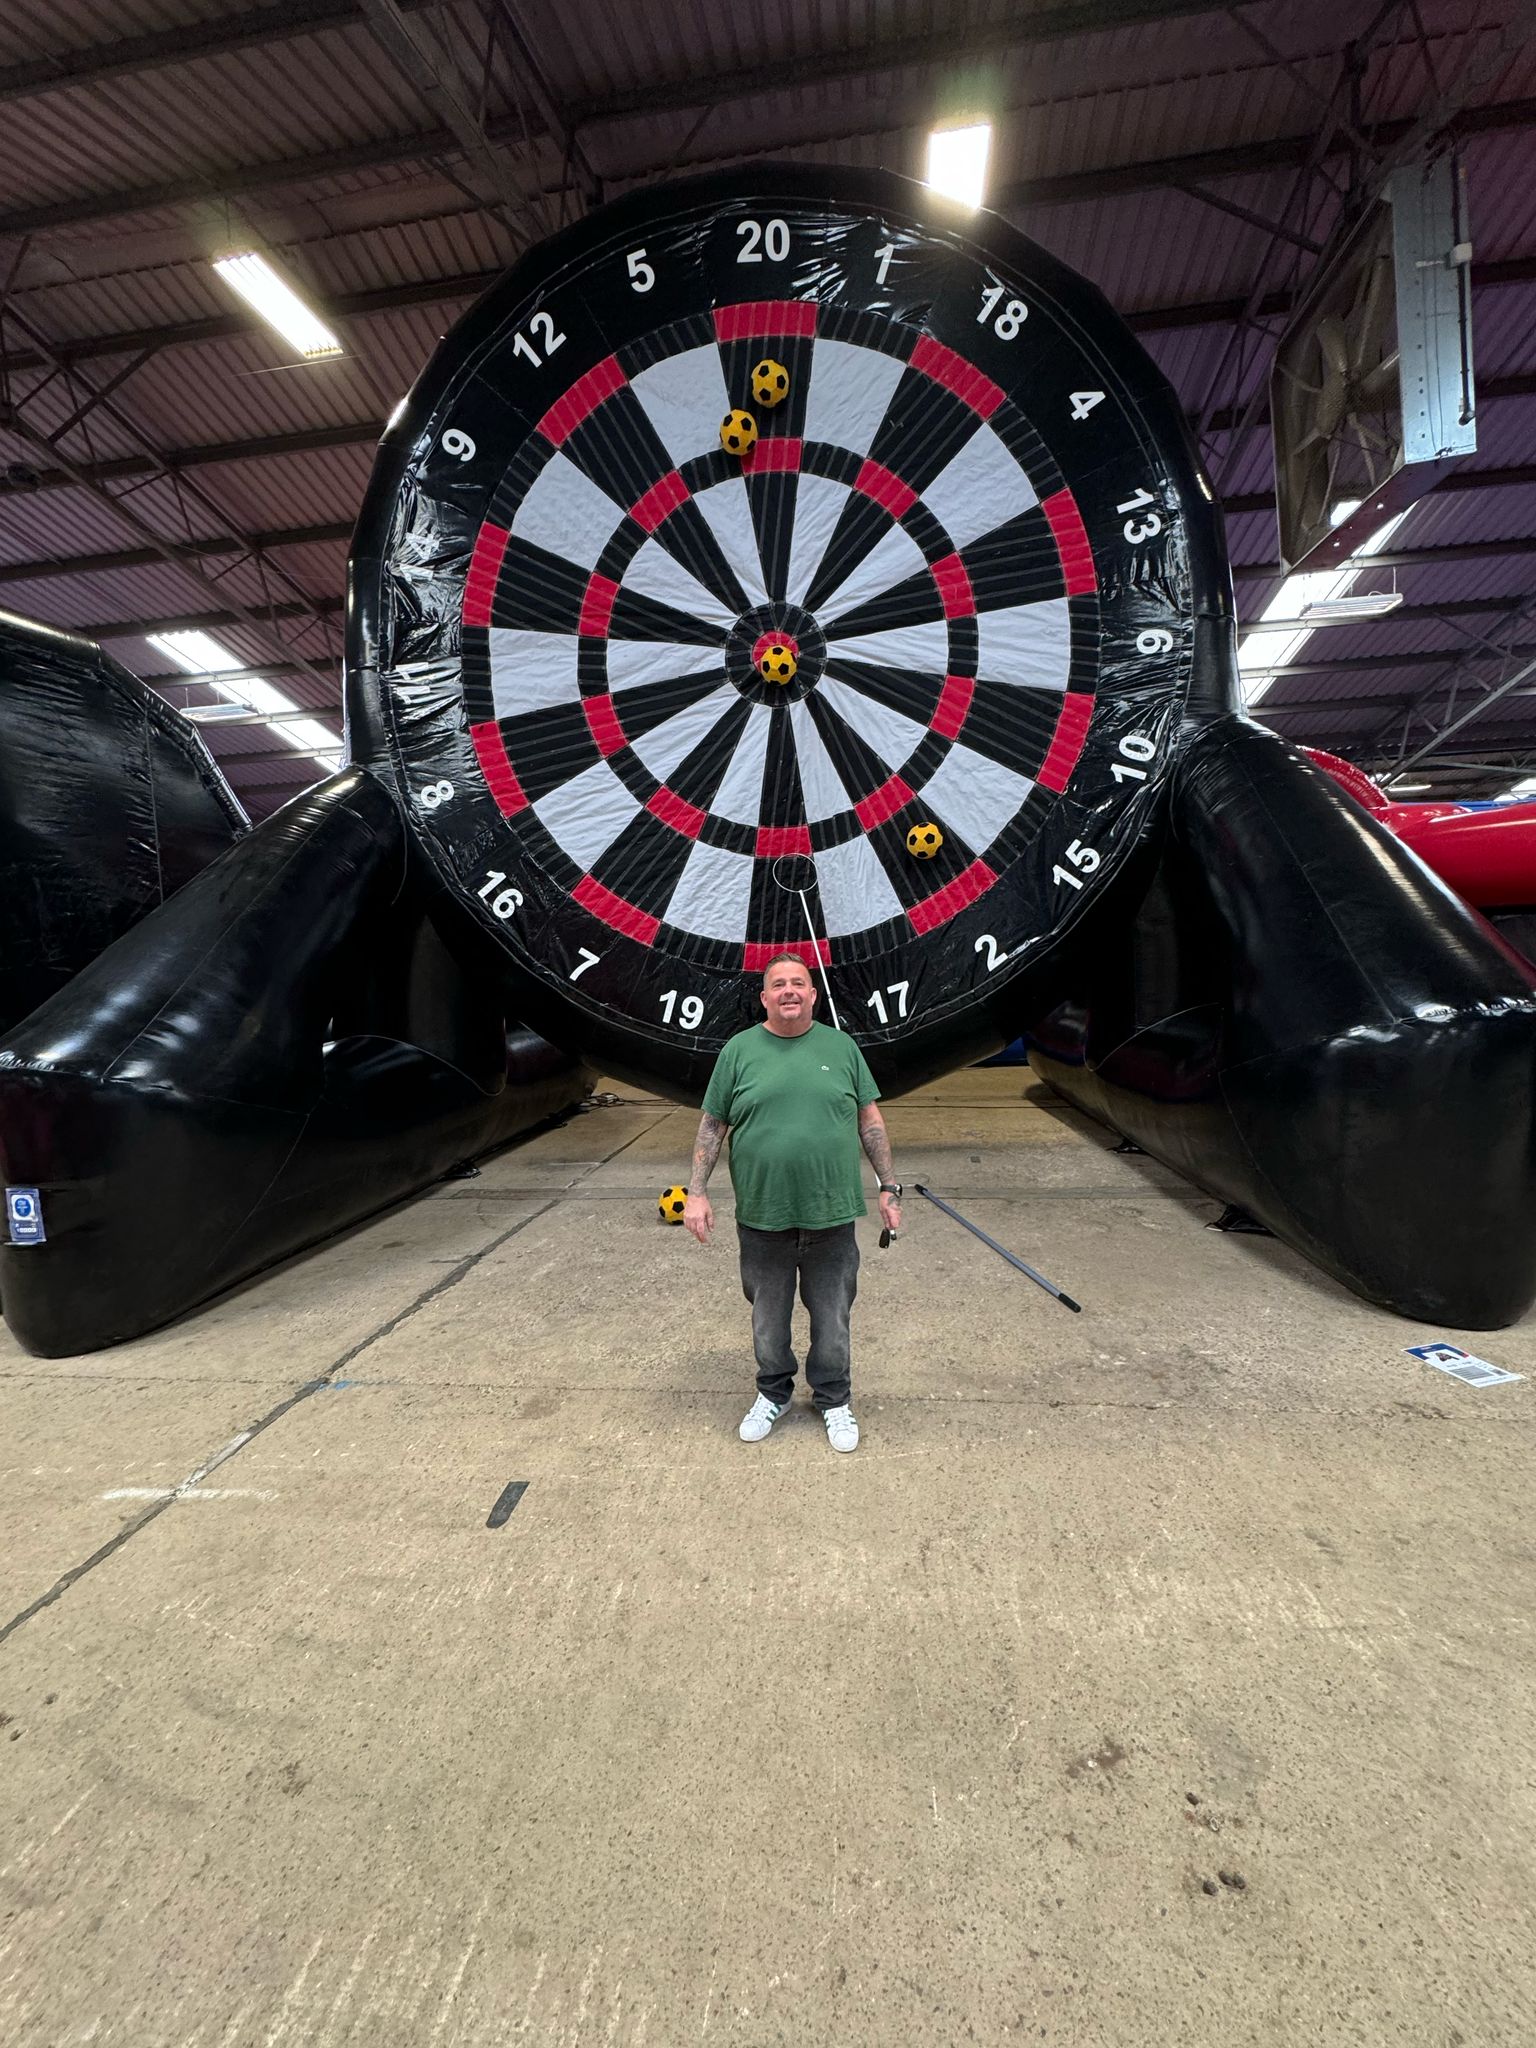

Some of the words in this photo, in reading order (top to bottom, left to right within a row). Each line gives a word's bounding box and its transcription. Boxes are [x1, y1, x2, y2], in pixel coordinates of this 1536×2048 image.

[735, 219, 791, 263] 20
[626, 248, 656, 293] 5
[873, 243, 895, 285] 1
[975, 285, 1029, 341] 18
[512, 311, 568, 368] 12
[1068, 390, 1106, 421] 4
[441, 428, 477, 462] 9
[1116, 487, 1162, 545] 13
[395, 661, 431, 705] 11
[1110, 734, 1156, 784] 10
[420, 779, 455, 809] 8
[1052, 838, 1101, 891] 15
[477, 870, 524, 919] 16
[569, 947, 601, 982] 7
[974, 933, 1008, 972] 2
[658, 989, 705, 1030] 19
[867, 980, 910, 1025] 17
